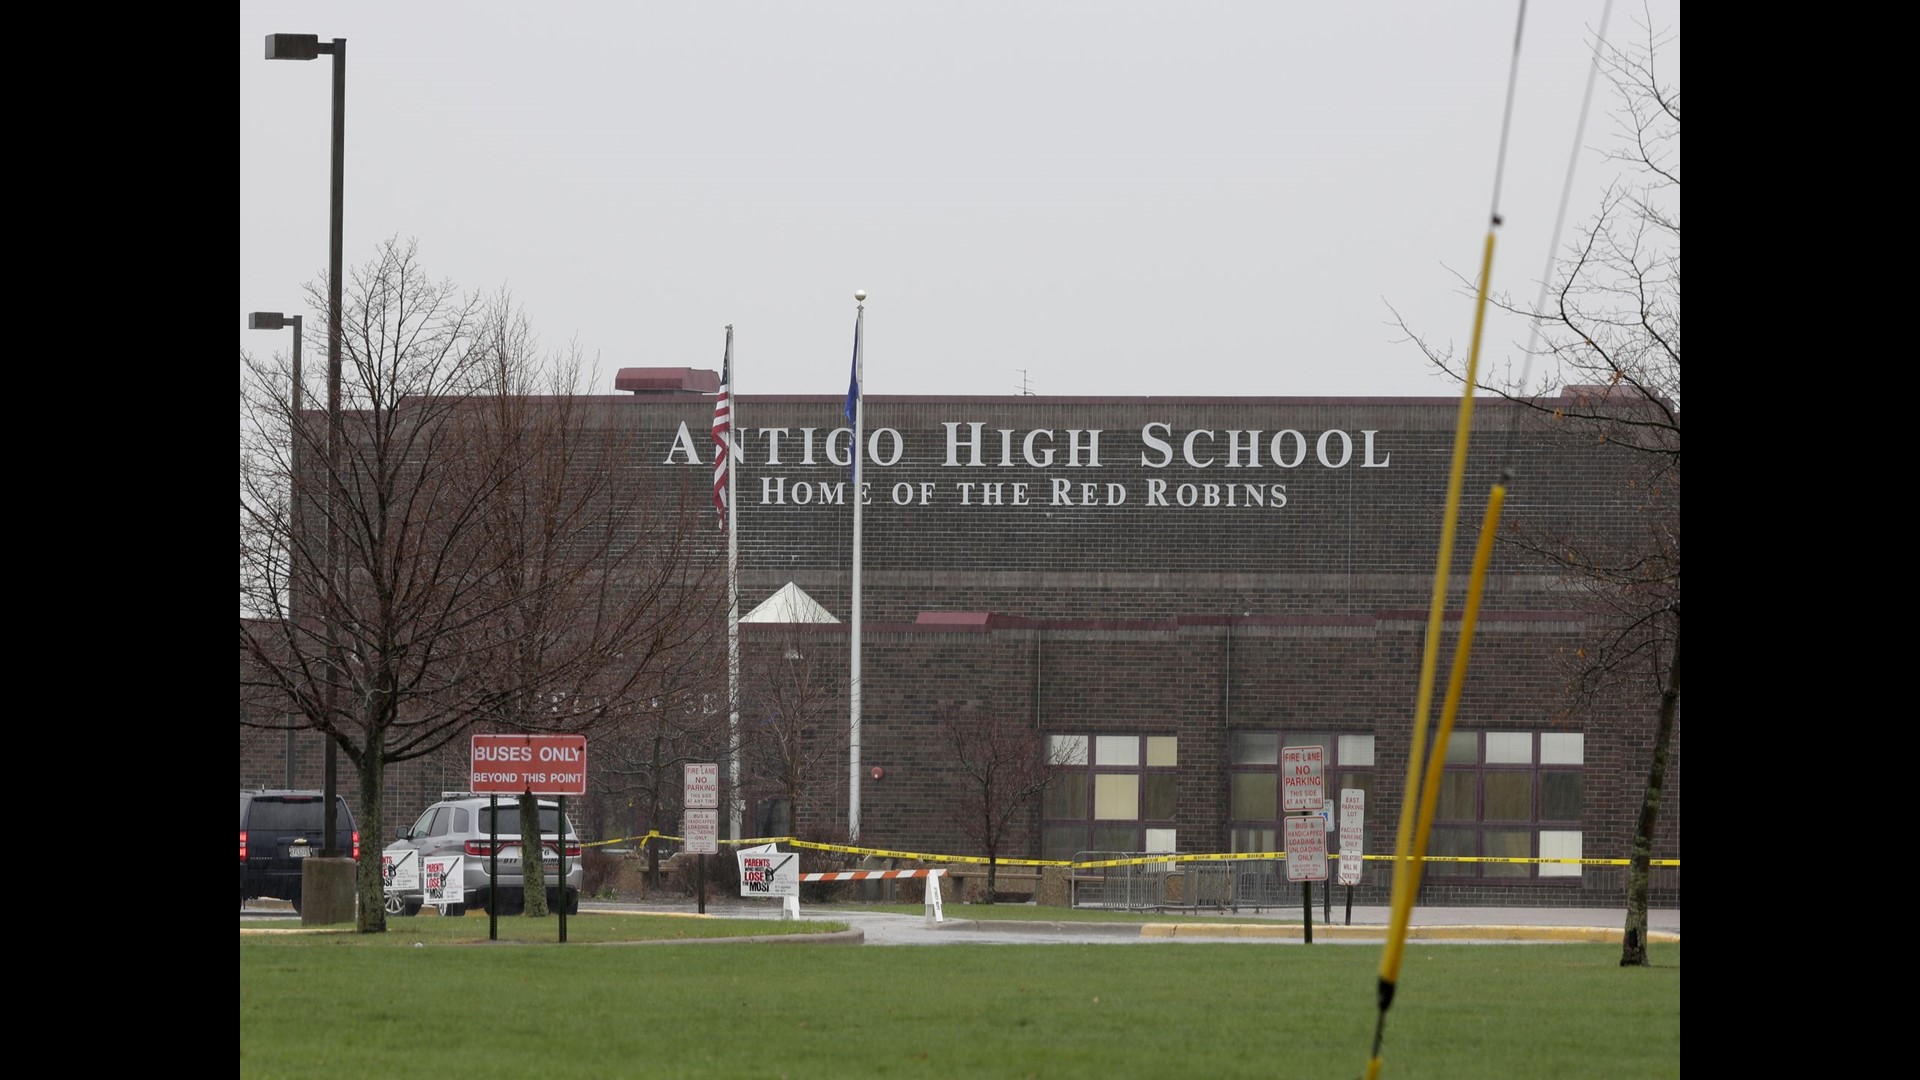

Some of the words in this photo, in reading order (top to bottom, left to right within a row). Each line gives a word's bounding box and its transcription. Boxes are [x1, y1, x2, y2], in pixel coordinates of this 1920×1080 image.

[941, 422, 1104, 467] HIGH
[1141, 422, 1391, 468] SCHOOL
[892, 482, 936, 505] OF
[957, 483, 1030, 505] THE
[1050, 478, 1127, 506] RED
[1145, 478, 1288, 508] ROBINS
[474, 746, 532, 761] BUSES
[540, 746, 580, 762] ONLY
[1285, 753, 1300, 762] FIRE
[1303, 752, 1320, 761] LANE
[1296, 765, 1311, 775] NO
[474, 772, 517, 783] BEYOND
[522, 772, 546, 783] THIS
[550, 773, 582, 783] POINT
[1285, 777, 1321, 787] PARKING
[744, 858, 771, 868] PARENTS
[744, 871, 765, 882] LOSE
